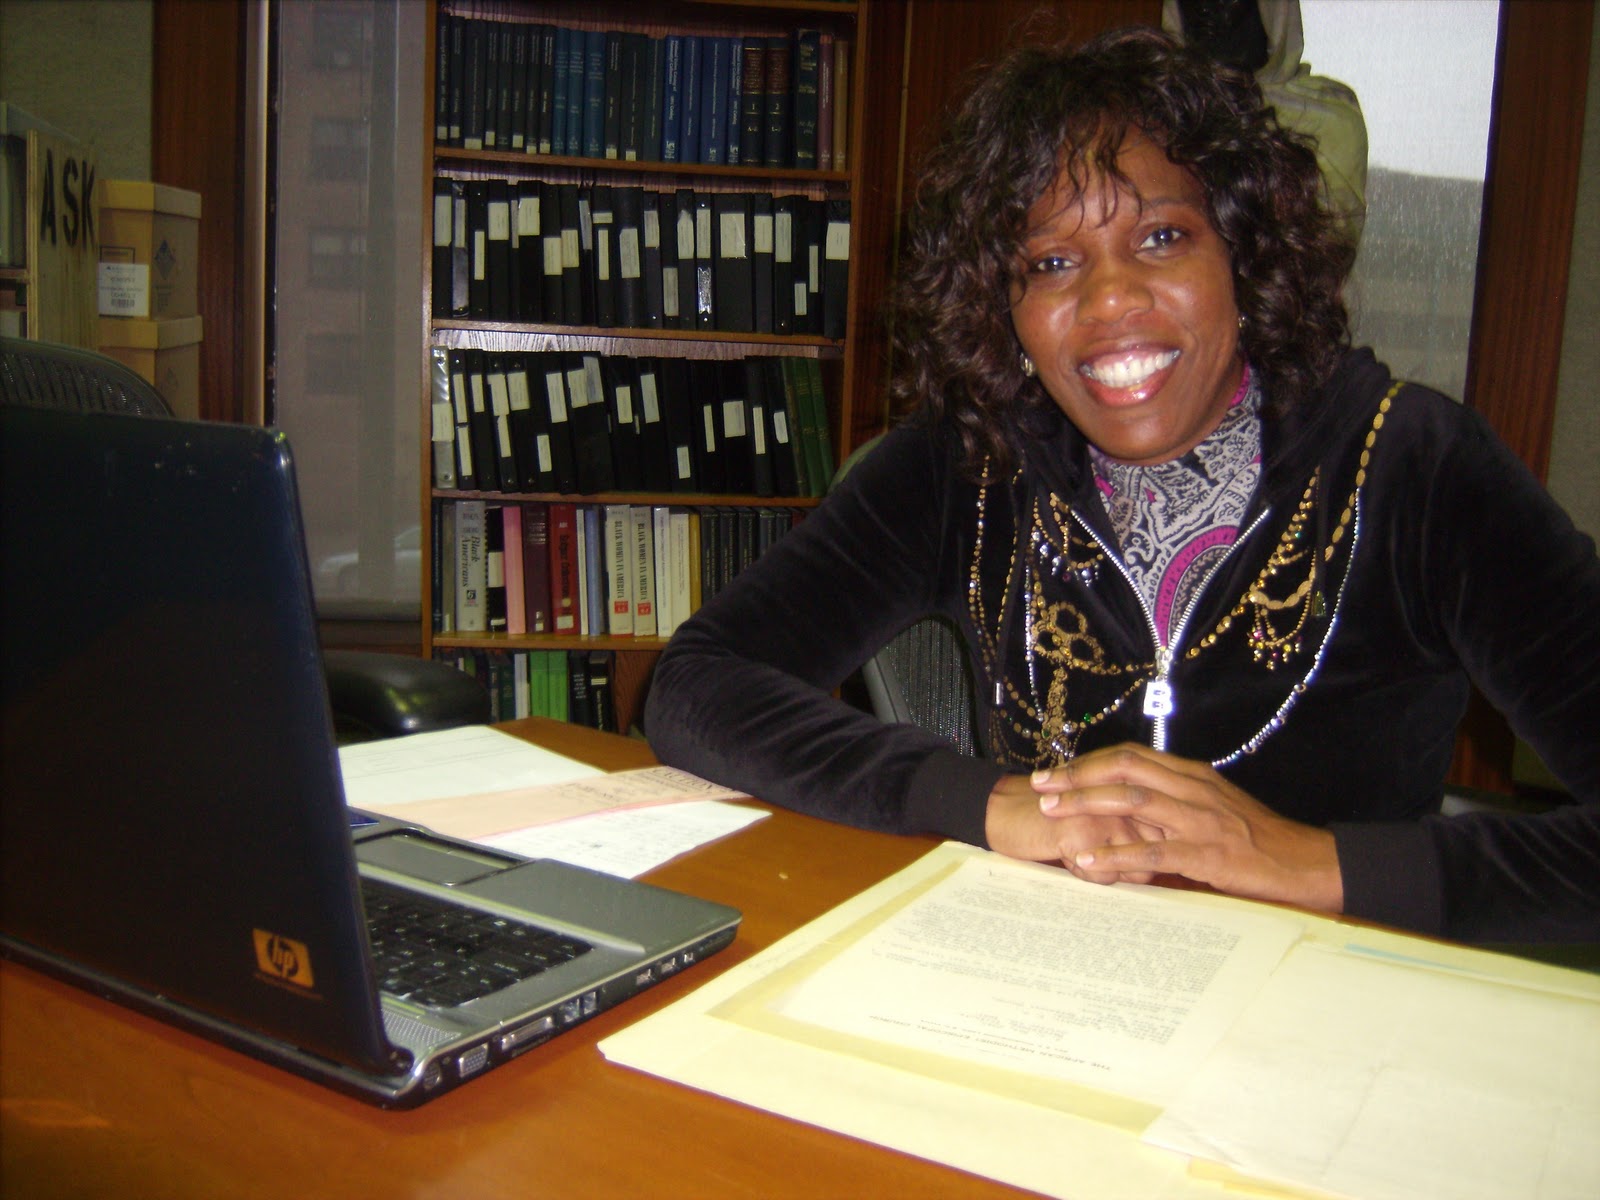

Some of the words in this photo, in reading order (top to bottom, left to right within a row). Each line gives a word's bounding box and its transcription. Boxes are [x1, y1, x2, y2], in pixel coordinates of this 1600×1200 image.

[41, 148, 96, 251] ASK
[614, 520, 623, 540] BLACK
[638, 523, 646, 542] BLACK
[471, 536, 480, 562] Black
[615, 541, 624, 563] WOMEN
[638, 543, 647, 565] WOMEN
[461, 535, 471, 587] Americans
[616, 573, 625, 599] AMERICA
[639, 575, 648, 600] AMERICA
[652, 768, 713, 794] CAUTION
[270, 934, 297, 978] hp
[868, 1016, 912, 1027] CHURCH
[917, 1025, 971, 1041] EPISCOPAL
[975, 1037, 1035, 1054] METHODIST
[1038, 1051, 1086, 1065] AFRICAN
[1090, 1062, 1111, 1072] THE
